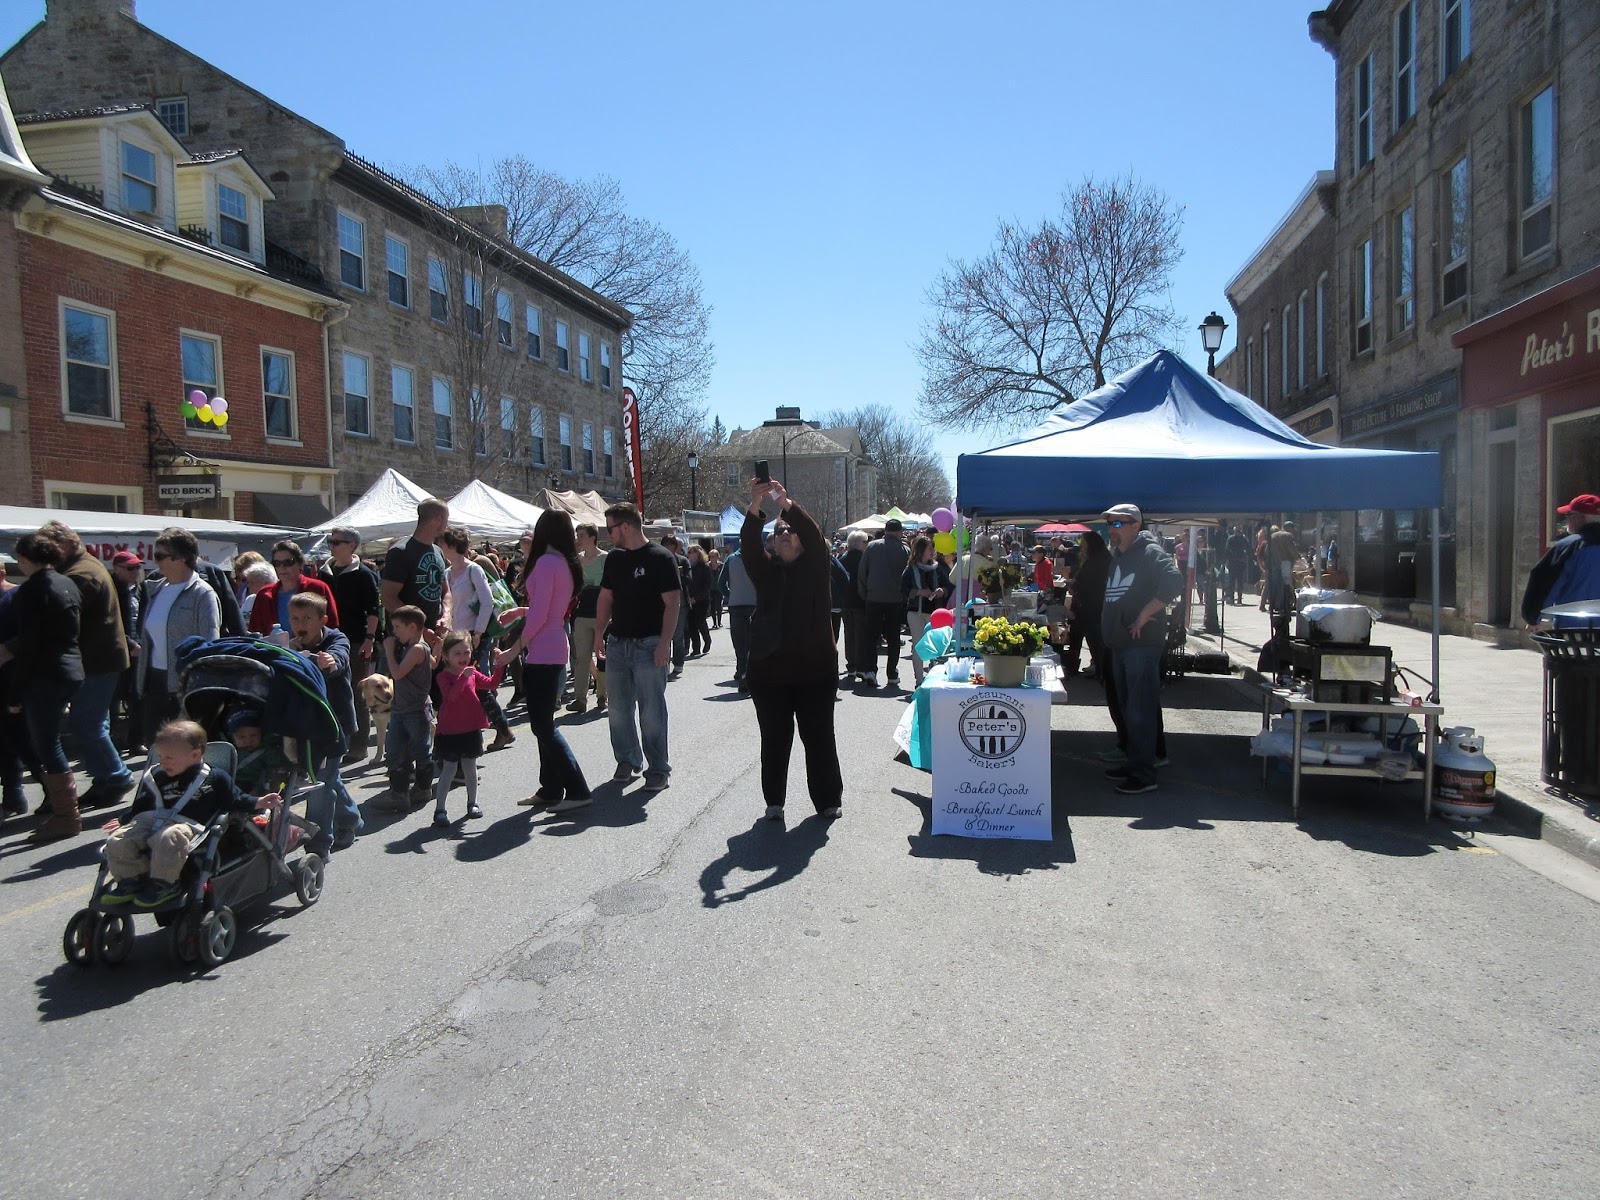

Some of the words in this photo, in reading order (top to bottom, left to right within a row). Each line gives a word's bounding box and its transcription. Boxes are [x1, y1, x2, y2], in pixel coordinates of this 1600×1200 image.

[1520, 321, 1575, 376] Peter's
[1395, 397, 1423, 418] FRAMING
[1424, 390, 1442, 409] SHOP
[160, 487, 180, 495] RED
[182, 487, 212, 495] BRICK
[958, 691, 1026, 711] Restaurant
[967, 721, 1017, 732] Peter's
[967, 754, 1016, 769] Bakery
[998, 783, 1029, 795] Goods
[1006, 803, 1044, 816] Lunch
[964, 815, 978, 830] &
[977, 819, 1016, 831] Dinner
